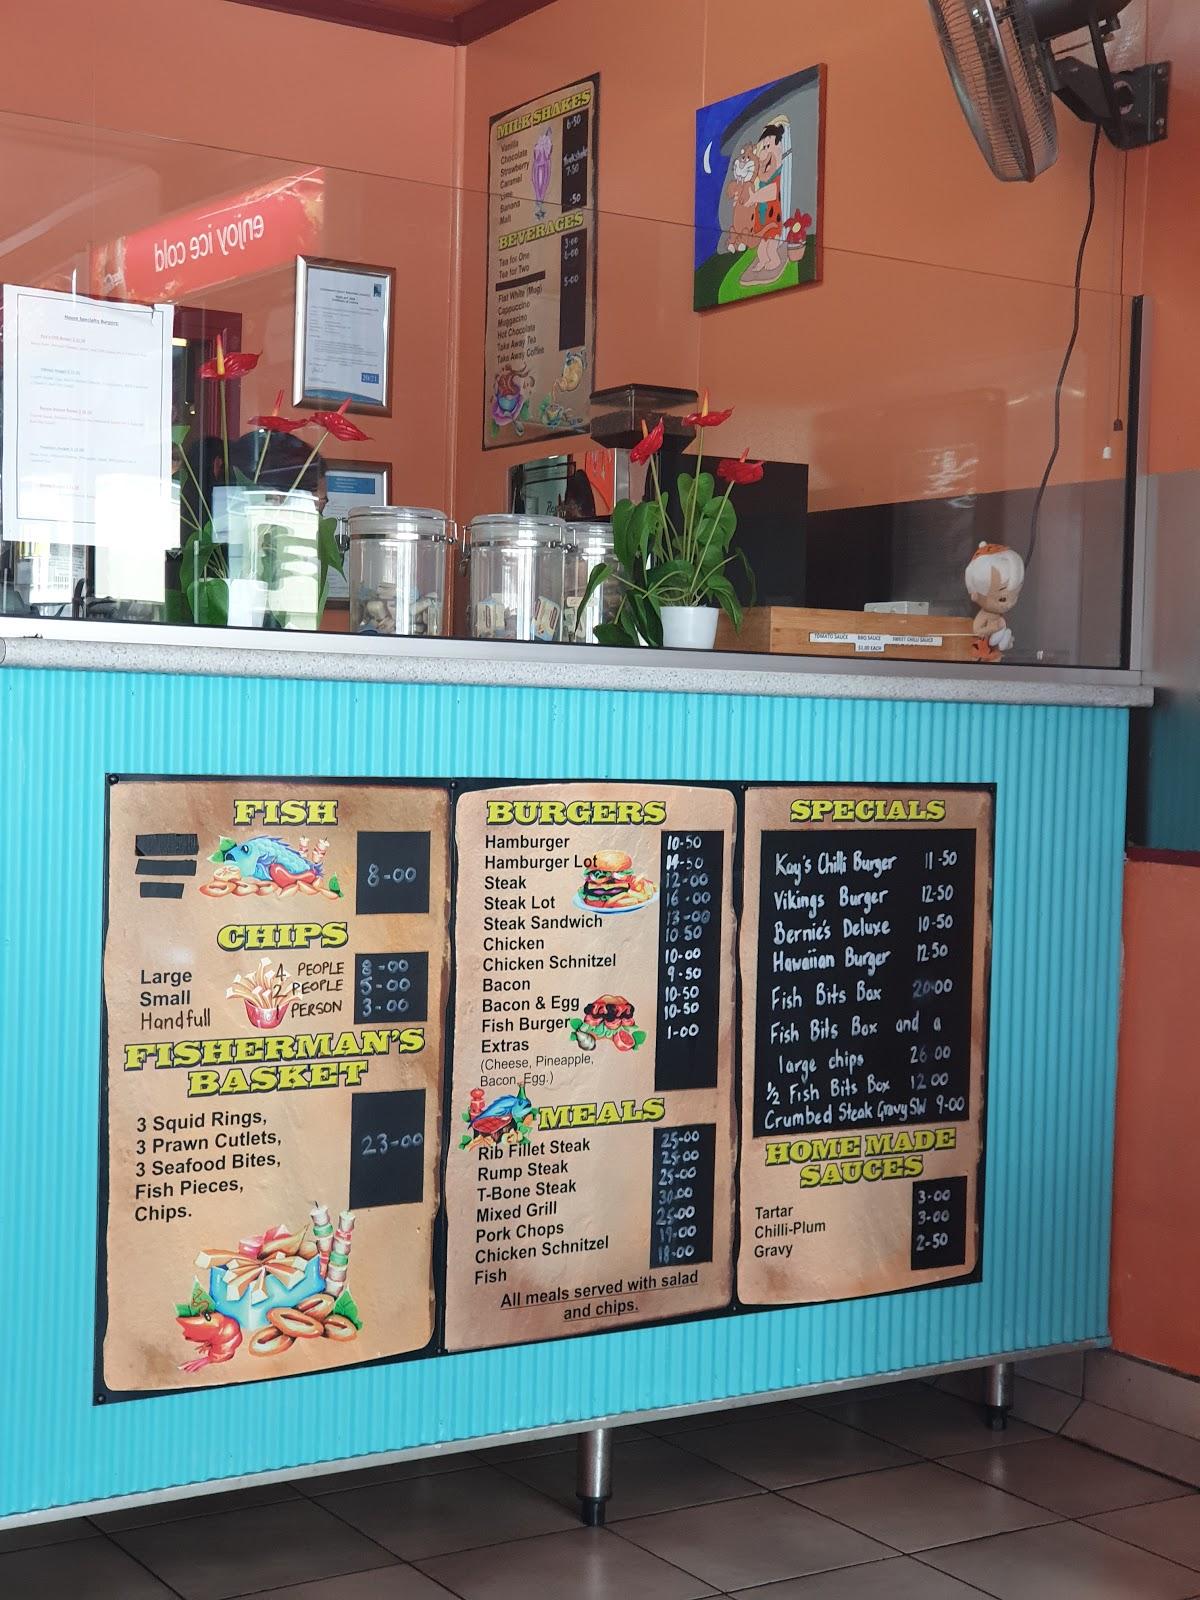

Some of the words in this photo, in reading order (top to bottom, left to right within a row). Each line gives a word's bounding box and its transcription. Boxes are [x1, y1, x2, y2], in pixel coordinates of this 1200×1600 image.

[497, 113, 531, 140] MILK
[532, 90, 591, 125] SHAKES
[501, 149, 528, 165] Chocolate
[500, 160, 529, 177] Strawberry
[500, 174, 522, 189] Caramel
[500, 200, 520, 213] Banana
[498, 212, 583, 250] BEVERAGES
[234, 800, 338, 825] FISH
[486, 801, 667, 825] BURGERS
[790, 800, 946, 823] SPECIALS
[485, 835, 570, 850] Hamburger
[667, 835, 702, 850] 10-50
[484, 855, 570, 871] Hamburger
[574, 854, 598, 868] Lot
[775, 853, 812, 885] Kay's
[853, 852, 898, 879] Burger
[367, 863, 417, 887] 8-00
[484, 875, 527, 890] Steak
[484, 896, 526, 910] Steak
[532, 896, 556, 909] Lot
[774, 888, 825, 919] Vikings
[839, 886, 889, 914] Burger
[484, 916, 526, 931] Steak
[531, 915, 603, 929] Sandwich
[843, 916, 891, 938] Deluxe
[918, 915, 954, 933] 10-50
[217, 922, 348, 950] CHIPS
[483, 937, 545, 951] Chicken
[482, 956, 544, 972] Chicken
[549, 954, 616, 969] Schnitzel
[665, 948, 701, 964] 10-00
[845, 946, 891, 976] Burger
[140, 970, 192, 986] Large
[275, 964, 287, 980] 4
[298, 961, 344, 976] PEOPLE
[273, 983, 288, 998] 2
[292, 979, 344, 996] PEOPLE
[482, 978, 531, 992] Bacon
[665, 986, 700, 1002] 10-50
[140, 990, 191, 1006] Small
[482, 998, 530, 1012] Bacon
[535, 997, 546, 1010] &
[551, 996, 580, 1012] Egg
[771, 985, 802, 1011] Fish
[816, 980, 847, 1004] Bits
[857, 981, 882, 1001] Box
[291, 1001, 342, 1018] PERSON
[362, 997, 409, 1018] 3-00
[664, 1002, 700, 1020] 10-50
[141, 1012, 210, 1030] Handfull
[482, 1018, 514, 1033] Fish
[519, 1017, 571, 1033] Burger
[770, 1020, 799, 1045] Fish
[810, 1018, 839, 1041] Bits
[851, 1015, 878, 1037] Box
[896, 1011, 920, 1032] and
[934, 1016, 942, 1031] a
[668, 1025, 700, 1039] 1-00
[124, 1028, 425, 1071] FISHERMAN'S
[481, 1039, 529, 1053] Extras
[480, 1057, 532, 1073] (Cheese,
[536, 1054, 594, 1070] Pineapple,
[779, 1056, 817, 1084] large
[828, 1048, 865, 1075] chips
[187, 1060, 368, 1097] BASKET
[790, 1082, 820, 1106] Fish
[831, 1074, 857, 1097] Bits
[867, 1074, 890, 1093] Box
[538, 1097, 666, 1131] MEALS
[765, 1103, 833, 1130] Crumbed
[839, 1099, 873, 1121] Steak
[936, 1096, 965, 1114] 9-00
[137, 1118, 146, 1131] 3
[152, 1113, 205, 1132] Squid
[212, 1110, 267, 1128] Rings,
[136, 1140, 146, 1154] 3
[152, 1136, 208, 1154] Prawn
[215, 1130, 282, 1148] Cutlets,
[361, 1132, 424, 1155] 23-00
[478, 1144, 504, 1161] Rib
[509, 1141, 545, 1158] Fillet
[550, 1138, 590, 1154] Steak
[765, 1136, 861, 1166] HOME
[864, 1128, 956, 1156] MADE
[136, 1162, 145, 1177] 3
[152, 1156, 226, 1176] Seafood
[232, 1153, 281, 1170] Bites,
[478, 1165, 523, 1182] Rump
[528, 1160, 569, 1177] Steak
[800, 1155, 924, 1188] SAUCES
[135, 1183, 174, 1200] Fish
[180, 1179, 244, 1196] Pieces,
[477, 1184, 530, 1202] T-Bone
[536, 1180, 577, 1196] Steak
[918, 1189, 951, 1204] 3-00
[134, 1203, 192, 1222] Chips.
[476, 1204, 521, 1222] Mixed
[526, 1201, 557, 1218] Grill
[755, 1206, 794, 1219] Tartar
[918, 1210, 950, 1225] 3-00
[476, 1224, 511, 1243] Pork
[516, 1222, 564, 1242] Chops
[754, 1221, 826, 1238] Chilli-Plum
[475, 1246, 537, 1264] Chicken
[542, 1236, 609, 1256] Schnitzel
[754, 1245, 793, 1258] Gravy
[916, 1233, 948, 1251] 2-50
[474, 1268, 508, 1285] Fish
[500, 1292, 521, 1308] All
[525, 1287, 569, 1304] meals
[574, 1279, 623, 1298] served
[628, 1276, 656, 1291] with
[661, 1270, 699, 1287] salad
[563, 1301, 590, 1320] and
[596, 1299, 639, 1318] chips.
